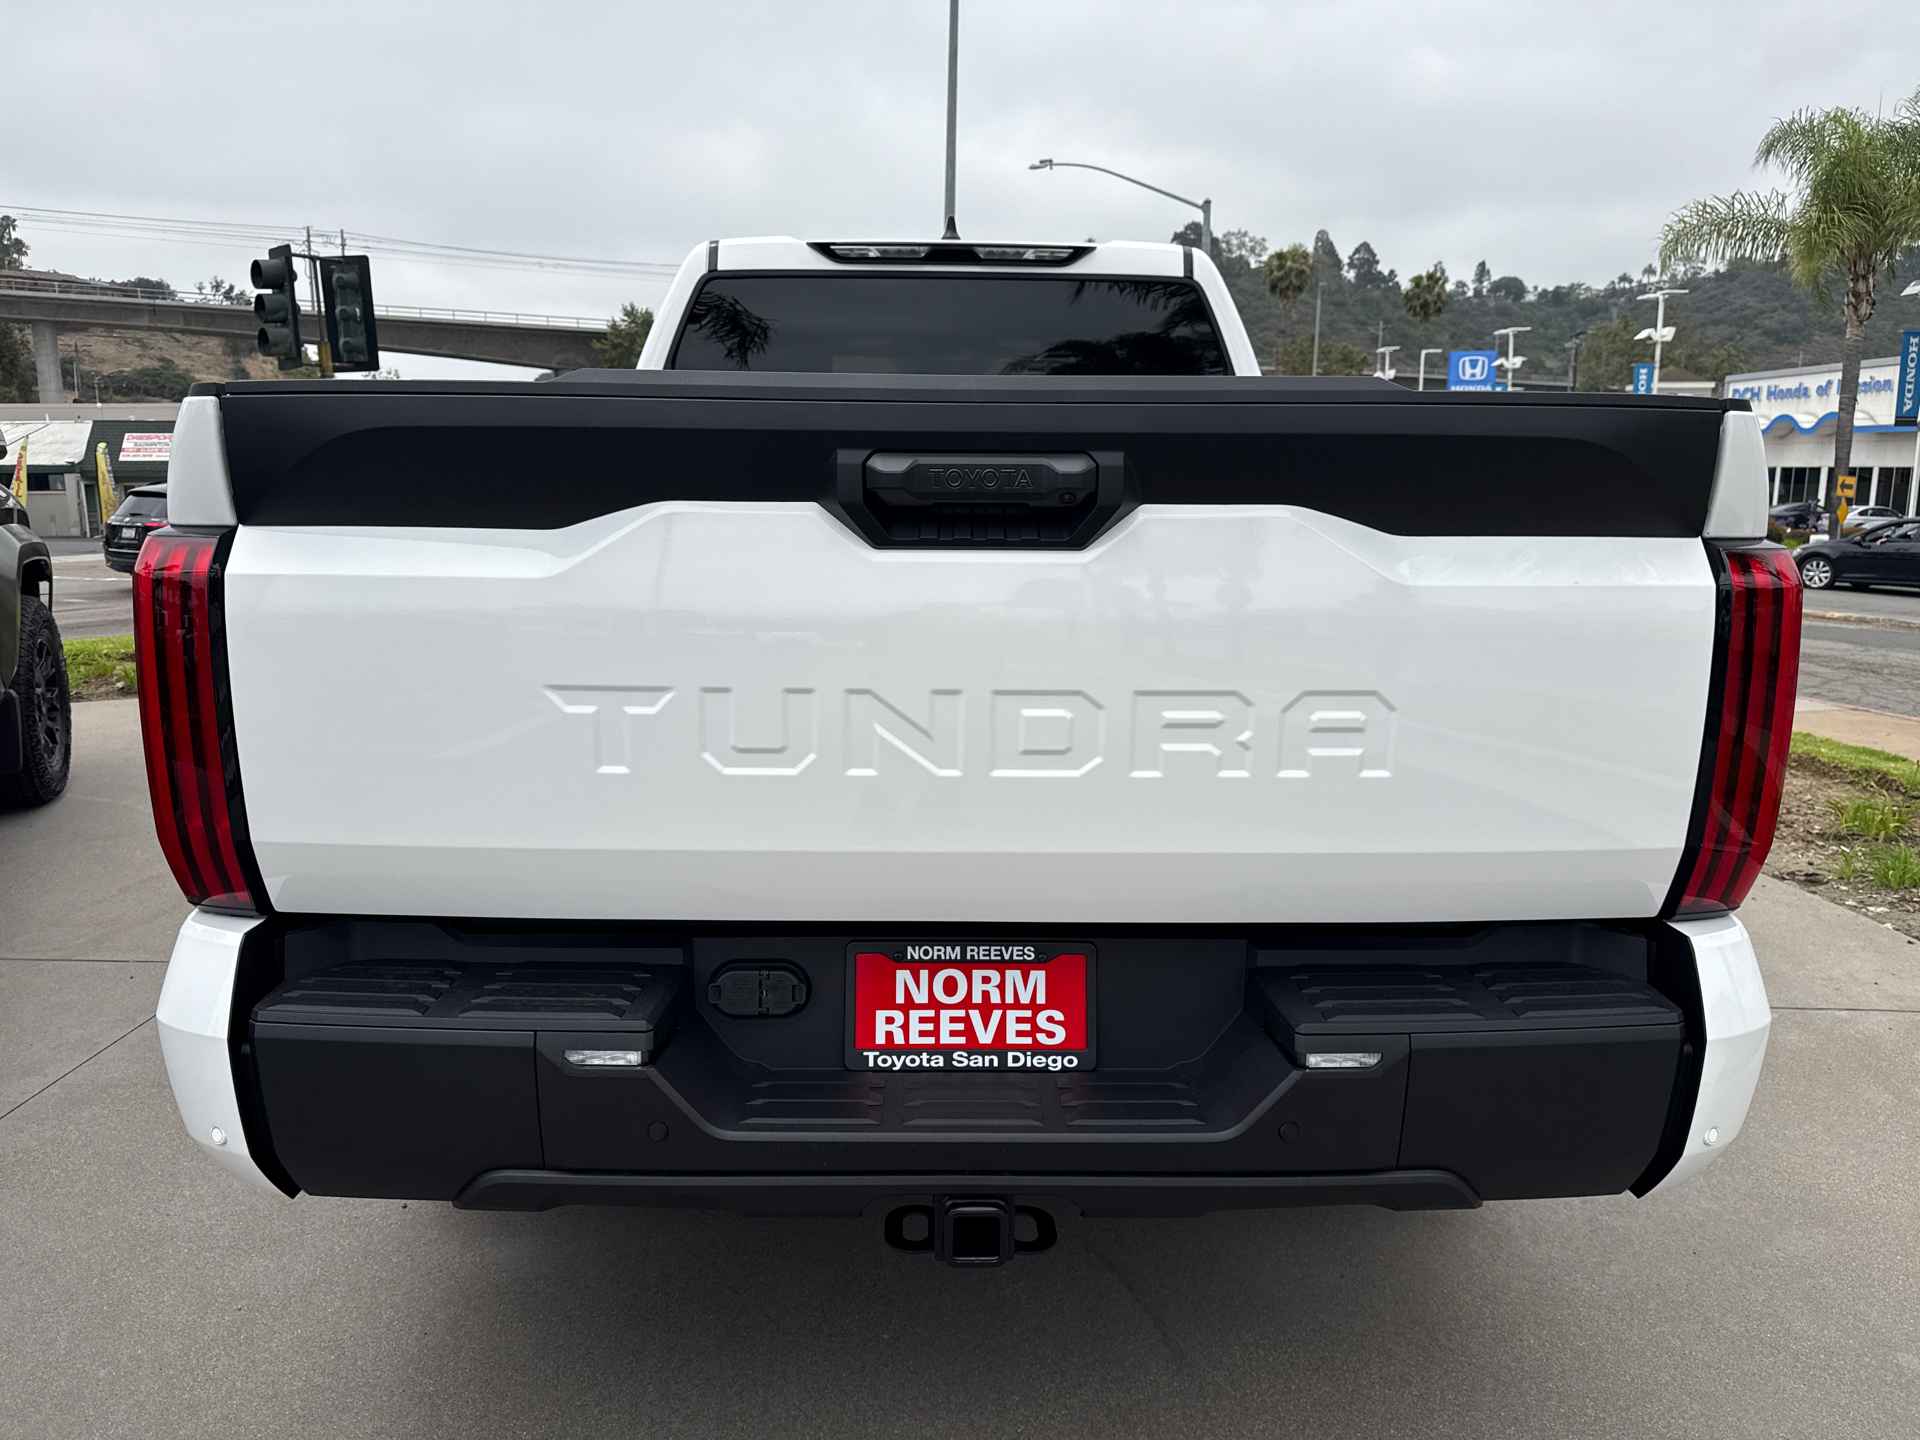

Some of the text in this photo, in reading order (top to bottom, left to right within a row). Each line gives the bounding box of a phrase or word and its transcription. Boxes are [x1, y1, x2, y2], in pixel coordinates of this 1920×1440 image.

[1732, 385, 1762, 401] DCH
[1766, 381, 1810, 400] Honda
[1816, 378, 1833, 396] of
[1903, 335, 1920, 414] HONDA
[15, 452, 24, 498] DETAIL
[928, 468, 1034, 489] TOYOTA
[542, 684, 1398, 778] TUNDRA
[906, 946, 1036, 961] NORM REEVES
[895, 968, 1047, 1004] NORM
[875, 1009, 1067, 1046] REEVES
[863, 1051, 1079, 1071] Toyota San Diego
